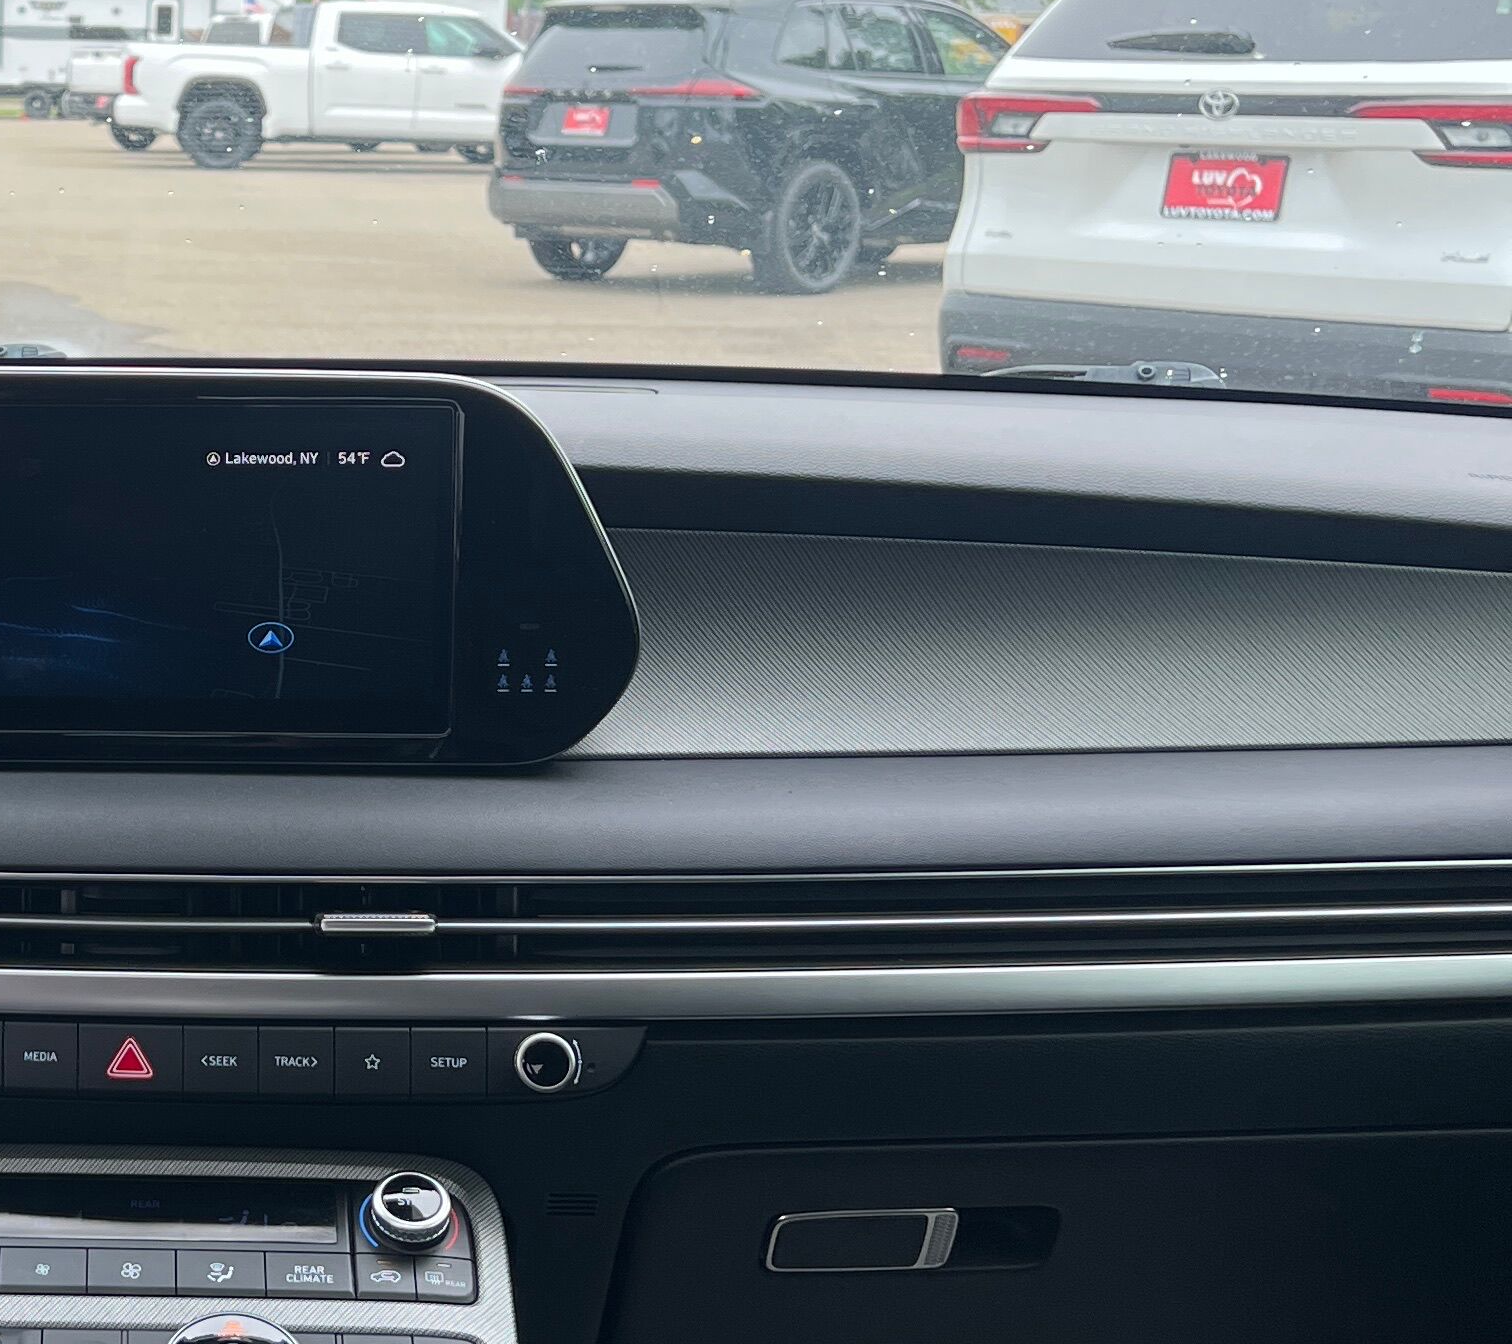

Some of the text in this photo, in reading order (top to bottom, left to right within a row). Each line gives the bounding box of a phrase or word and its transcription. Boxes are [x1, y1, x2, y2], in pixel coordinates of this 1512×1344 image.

[1192, 169, 1227, 185] LUV
[1196, 184, 1257, 197] TOYOTA
[225, 451, 319, 466] Lakewood, NY
[23, 1051, 57, 1062] MEDIA
[431, 1057, 467, 1068] SETUP
[294, 1265, 325, 1275] REAR
[286, 1273, 334, 1284] CLIMATE
[445, 1279, 467, 1289] REAR
